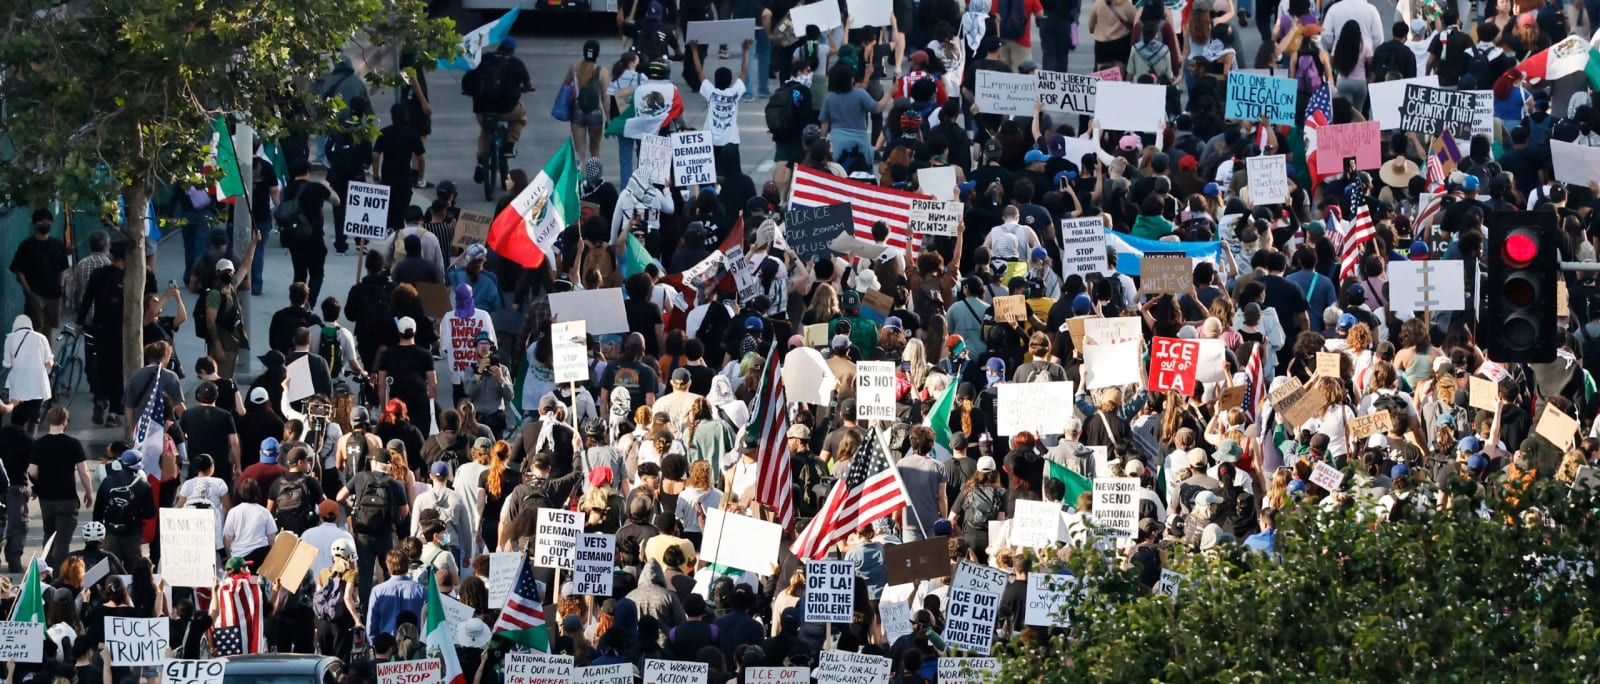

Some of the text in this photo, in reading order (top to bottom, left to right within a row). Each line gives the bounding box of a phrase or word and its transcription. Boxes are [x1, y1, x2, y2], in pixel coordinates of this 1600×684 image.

[1038, 72, 1060, 82] WITH
[1063, 74, 1100, 85] LIBERTY
[1230, 74, 1280, 90] NO ONE IS
[1038, 80, 1096, 95] AND JUSTIC
[1232, 86, 1294, 106] ILLEGAL ON
[1408, 86, 1472, 108] WE BUILT THE
[1040, 94, 1094, 113] FOR ALL
[1234, 102, 1295, 122] STOLEN LAND
[1406, 100, 1474, 122] COUNTRY THAT
[1402, 114, 1436, 134] HATES
[680, 134, 704, 144] VETS
[674, 146, 711, 156] DEMAND
[686, 165, 703, 174] OUT
[1252, 159, 1284, 171] Liberty
[680, 173, 710, 184] OF LA!
[1254, 178, 1285, 187] Justice
[350, 184, 388, 196] PROTESTING
[349, 194, 388, 210] IS NOT
[912, 200, 946, 211] PROTECT
[362, 212, 369, 223] A
[785, 207, 830, 227] FUCK ICE
[928, 212, 957, 222] HUMAN
[346, 222, 384, 237] CRIME!
[910, 220, 947, 232] RIGHTS!
[1079, 220, 1102, 228] RIGHTS
[786, 222, 845, 240] FUCK ZIONISM
[1077, 263, 1096, 272] NOW!
[1156, 340, 1195, 360] ICE
[1161, 360, 1191, 370] out of
[860, 376, 893, 387] IS NOT
[1158, 374, 1184, 391] LA
[875, 393, 880, 403] A
[859, 405, 894, 416] CRIME!
[1356, 417, 1373, 428] ICE
[1315, 474, 1335, 488] ICE
[1102, 494, 1131, 504] SEND
[549, 512, 575, 524] VETS
[1095, 510, 1136, 519] NATIONAL
[1102, 520, 1130, 528] GUARD
[540, 525, 581, 537] DEMAND
[554, 540, 576, 548] TROOP
[584, 537, 607, 548] VETS
[549, 547, 568, 557] OUT
[577, 551, 612, 562] DEMAND
[541, 556, 574, 568] OF LA!
[809, 564, 852, 575] ICE OUT
[961, 562, 1005, 586] THIS IS
[585, 573, 602, 583] OUT
[809, 576, 852, 590] OF LA!
[578, 583, 606, 594] OF LA!
[970, 579, 990, 591] OUR
[1162, 583, 1172, 595] IS
[808, 593, 851, 603] END THE
[953, 590, 996, 607] ICE OUT
[808, 604, 851, 614] VIOLENT
[1030, 600, 1052, 612] only
[951, 603, 994, 622] OF LA!
[113, 618, 160, 638] FUCK
[949, 619, 992, 635] END THE
[947, 630, 990, 646] VIOLENT
[106, 639, 167, 662] TRUMP
[971, 644, 988, 653] RAIDS!
[511, 655, 546, 663] NATIONAL
[821, 653, 840, 662] FULL
[939, 659, 995, 668] LOS GELES
[167, 661, 223, 678] GTFO
[378, 660, 440, 676] WORKERS ACTION
[531, 666, 546, 674] OUT
[583, 665, 621, 677] AGAINST
[647, 661, 707, 673] FOR WORKERS
[820, 663, 846, 672] RIGHTS
[864, 667, 878, 675] ALL
[396, 673, 430, 684] STOP
[510, 676, 524, 684] FOR
[656, 673, 688, 684] ACTION
[781, 670, 798, 679] OUT
[820, 674, 875, 683] IMMIGRANTS!
